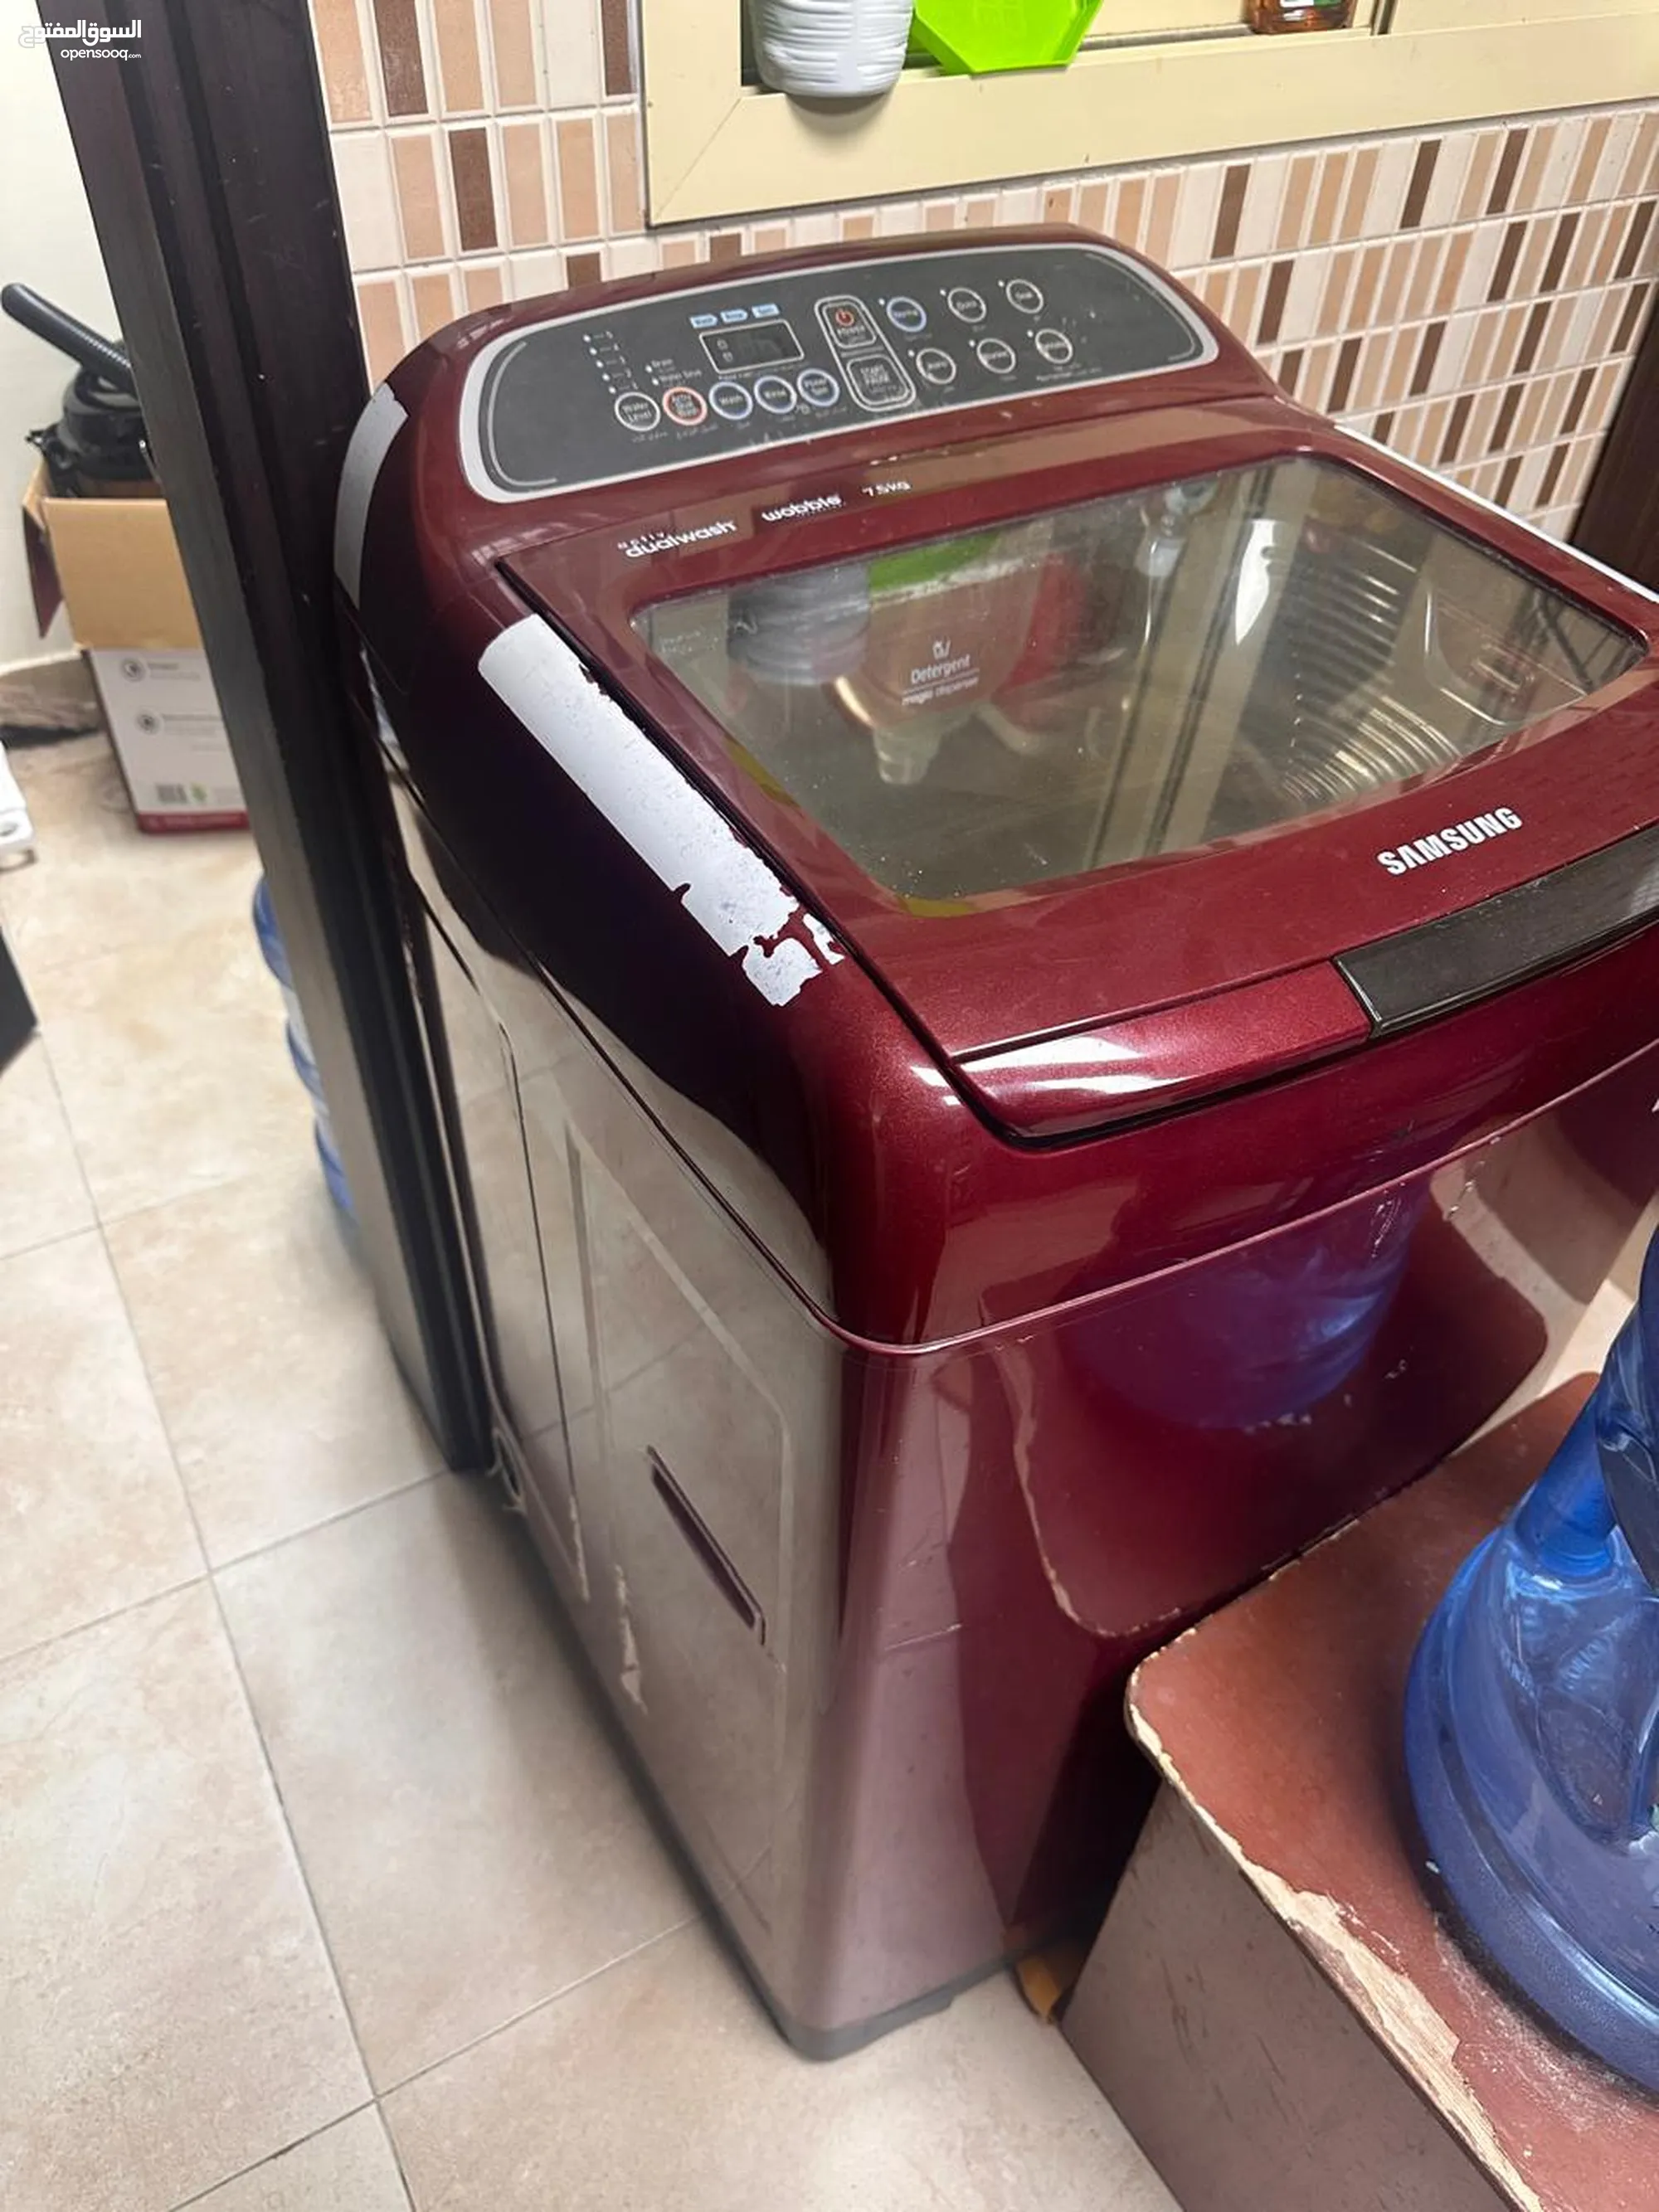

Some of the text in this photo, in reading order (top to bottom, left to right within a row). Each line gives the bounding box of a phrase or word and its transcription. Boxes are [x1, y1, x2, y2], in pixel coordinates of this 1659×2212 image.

[761, 492, 842, 522] wobble
[625, 520, 737, 558] dualwash
[1377, 807, 1523, 875] SAMSUNG
